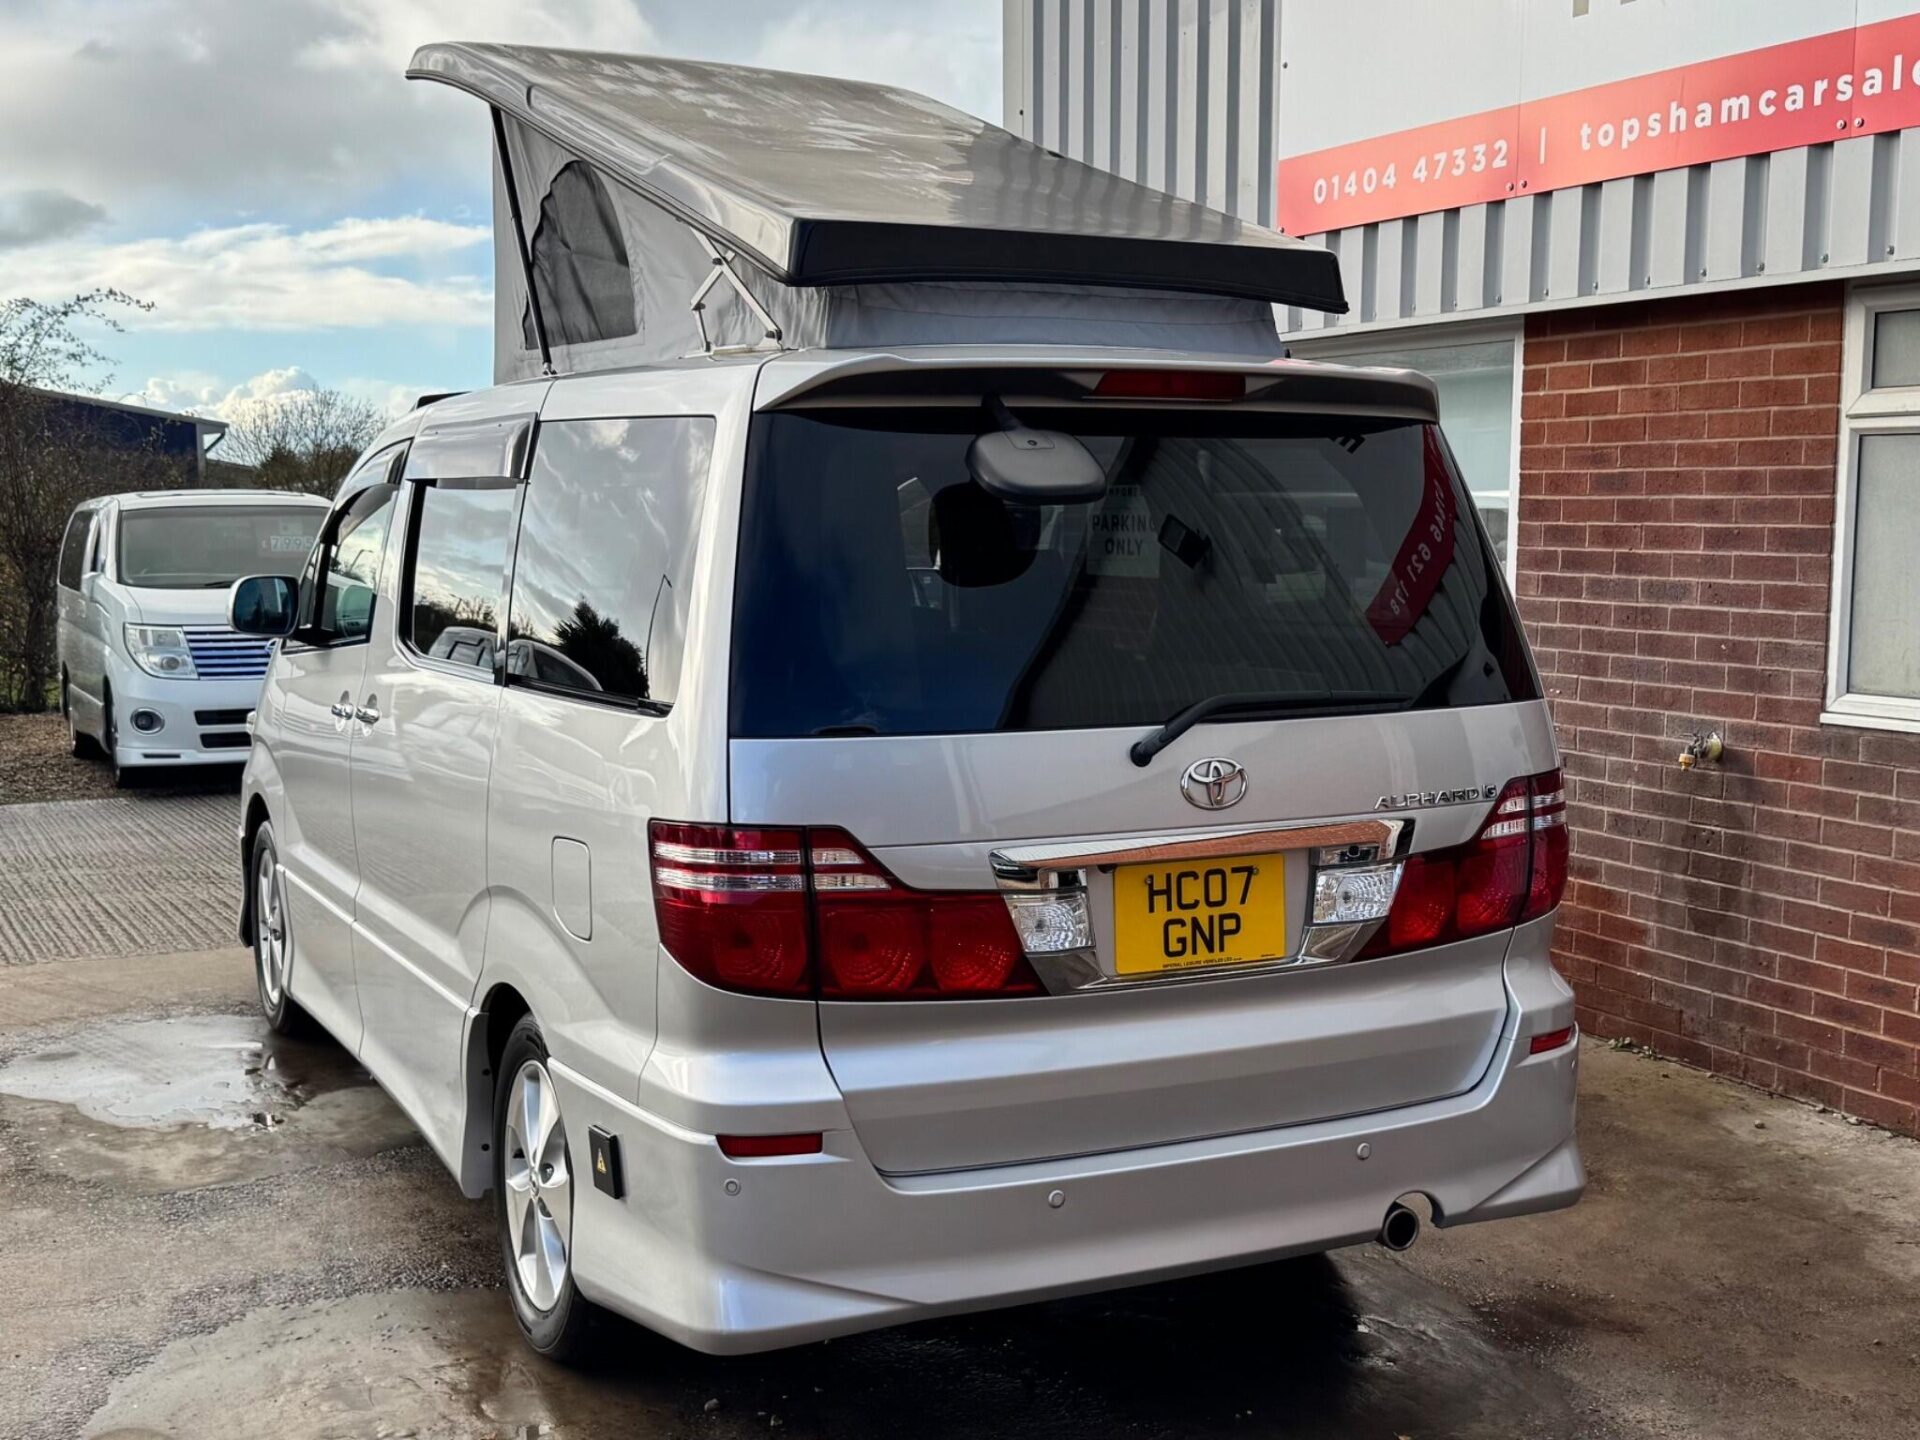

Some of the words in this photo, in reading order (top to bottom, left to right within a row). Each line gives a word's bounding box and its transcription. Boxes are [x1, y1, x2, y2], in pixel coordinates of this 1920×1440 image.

[1313, 163, 1396, 204] 01404
[1413, 139, 1508, 183] 47332
[1093, 513, 1158, 533] PARKING
[1105, 537, 1143, 557] ONLY
[1374, 786, 1479, 810] ALPHARD
[1147, 865, 1255, 914] HC07
[1163, 912, 1242, 958] GNP
